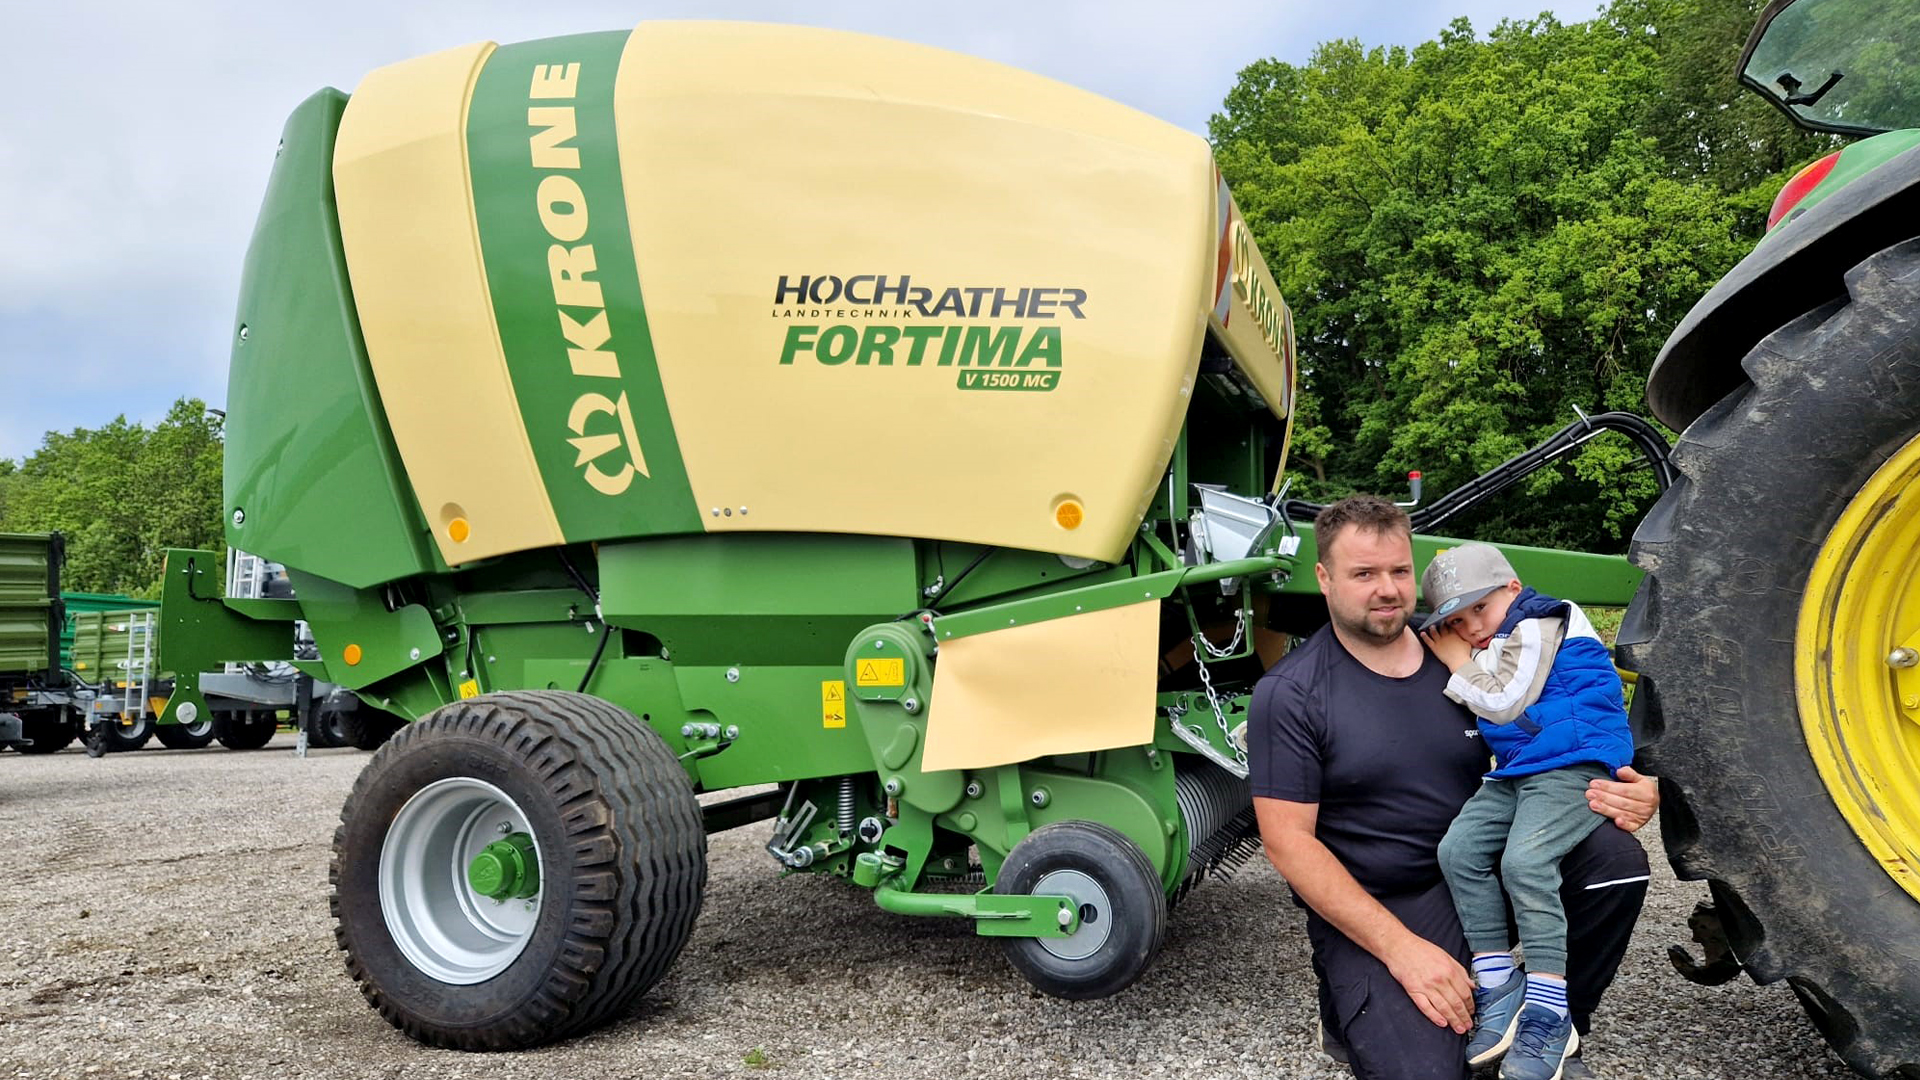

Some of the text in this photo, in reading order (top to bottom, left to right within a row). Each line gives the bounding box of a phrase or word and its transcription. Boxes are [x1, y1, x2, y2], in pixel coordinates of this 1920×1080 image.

[527, 62, 622, 378] KRONE
[772, 309, 913, 318] LANDTECHNIK
[1247, 266, 1285, 359] KRONE
[779, 325, 1063, 368] FORTIMA
[965, 374, 1052, 388] V 1500 MC
